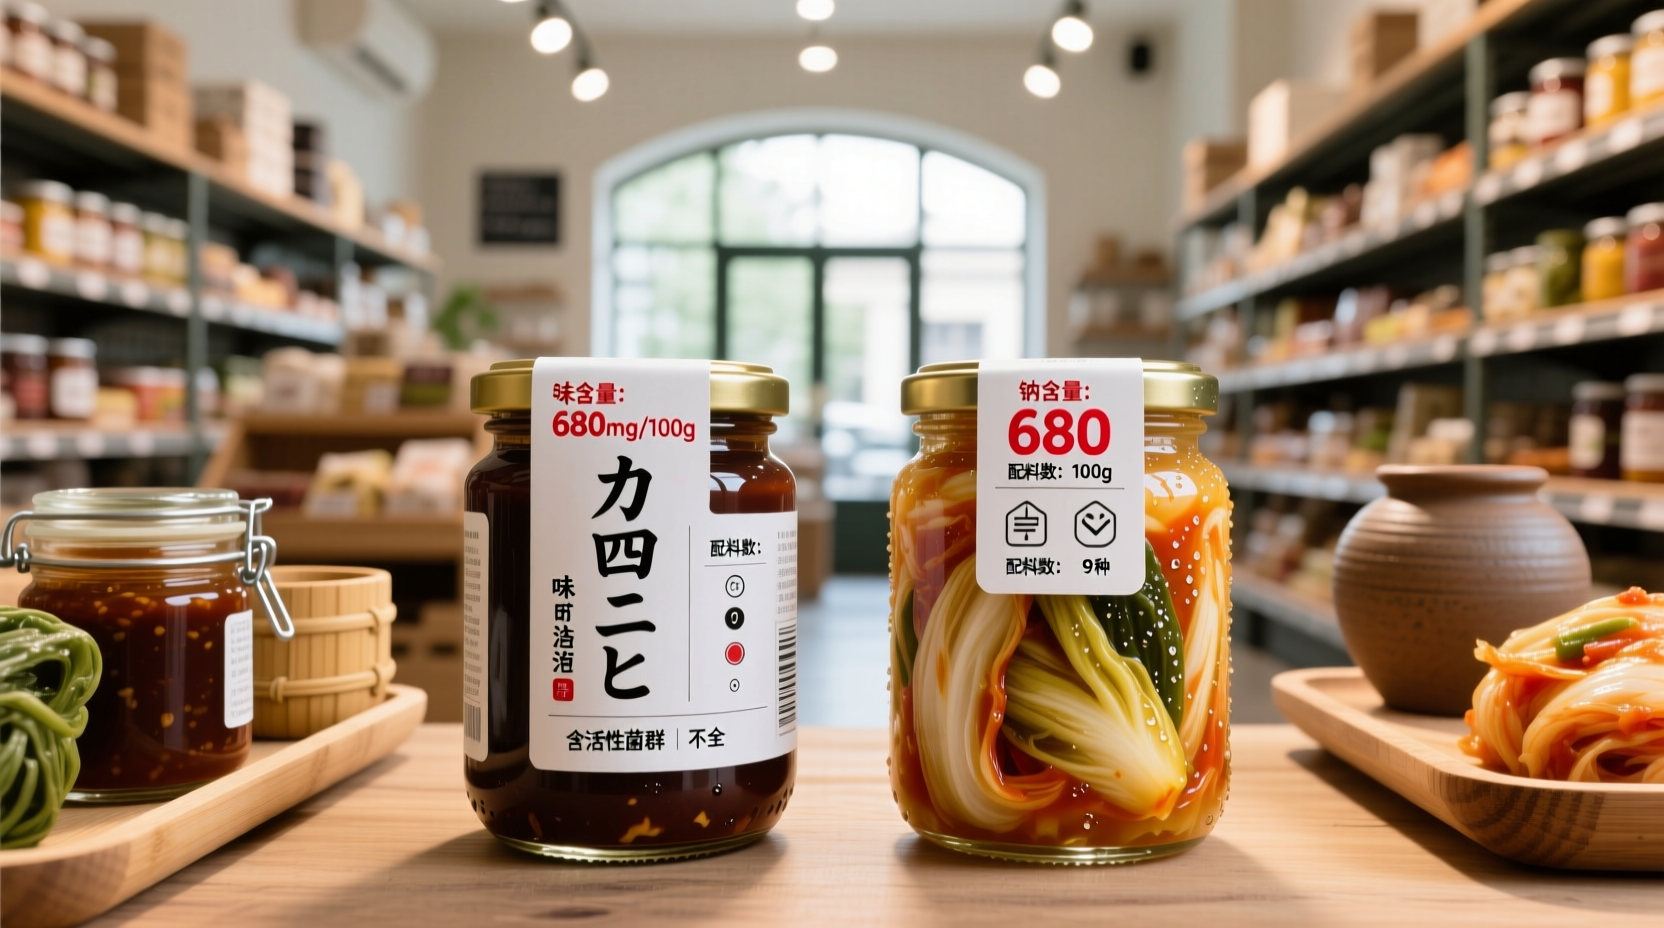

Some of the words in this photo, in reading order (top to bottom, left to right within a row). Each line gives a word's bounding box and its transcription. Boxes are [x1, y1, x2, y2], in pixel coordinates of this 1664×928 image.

[1018, 379, 1090, 402] 钠含量：
[552, 410, 696, 443] 680mg/100g
[1007, 408, 1112, 456] 680
[1072, 463, 1112, 484] 100g
[1083, 557, 1111, 577] 9种
[566, 728, 666, 752] 含活性菌群
[688, 726, 726, 750] 不全
